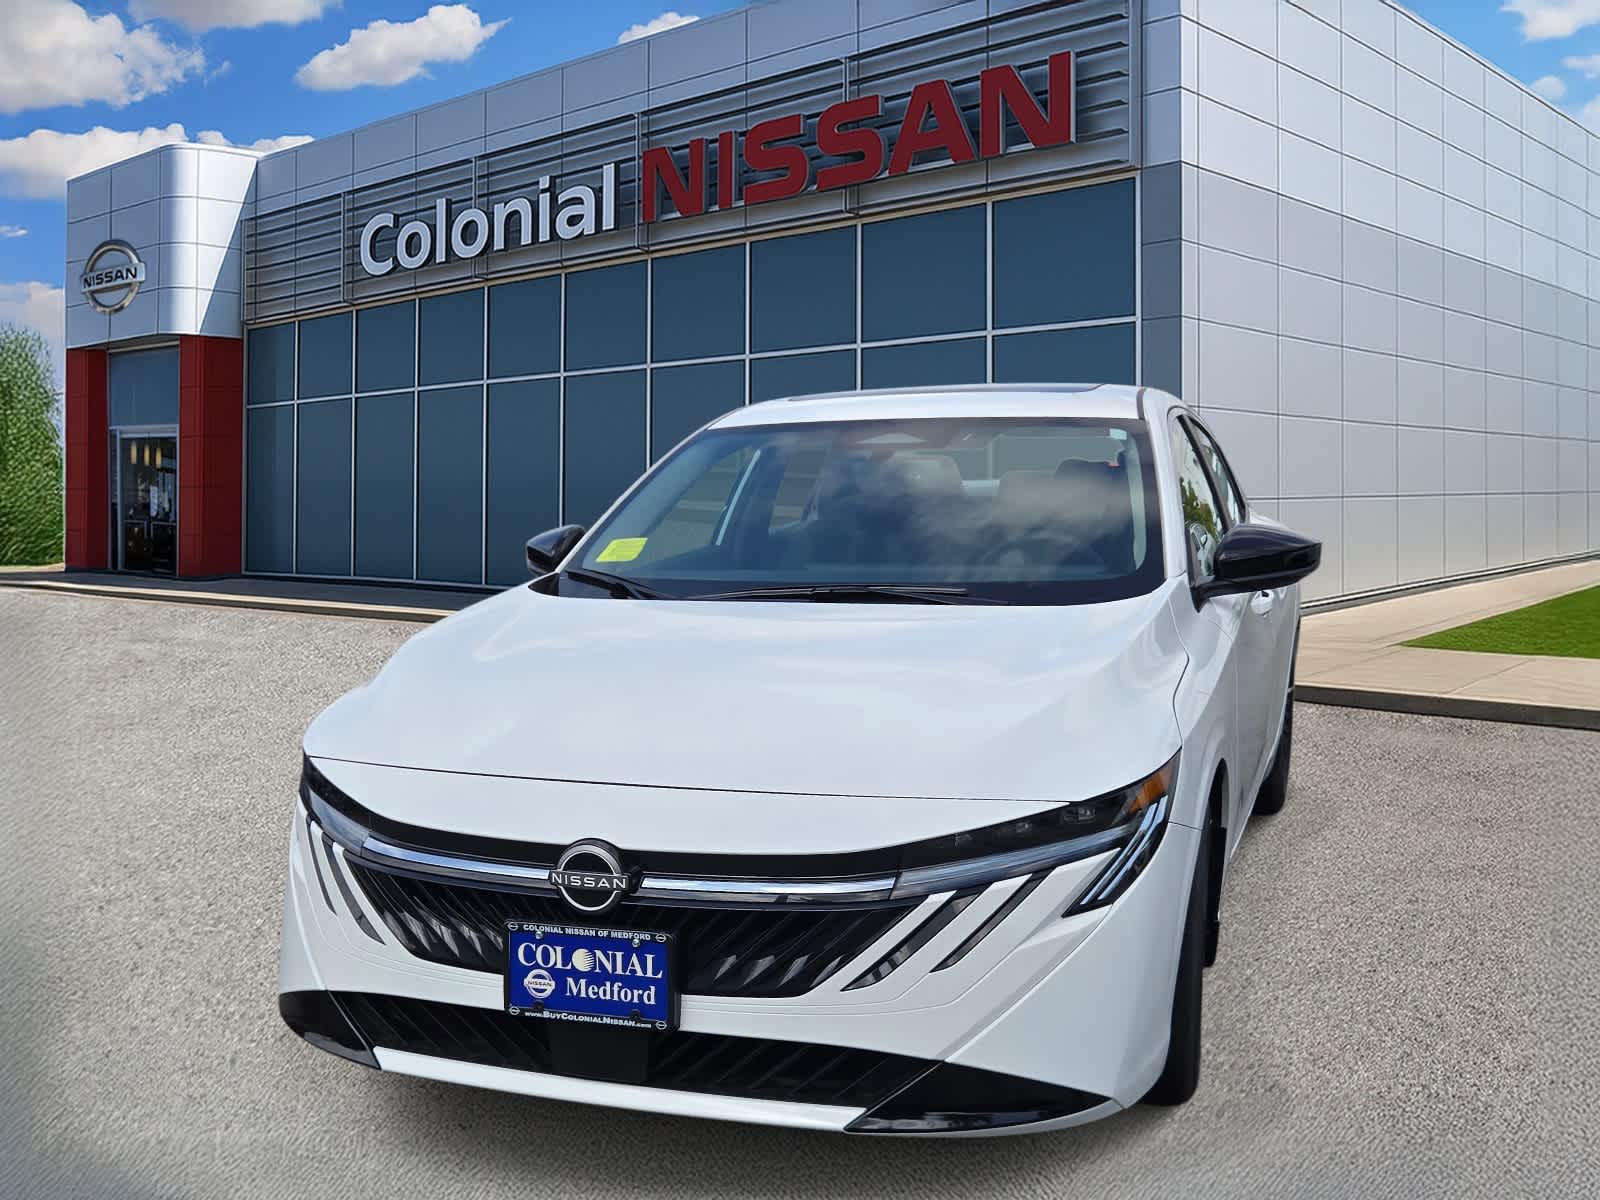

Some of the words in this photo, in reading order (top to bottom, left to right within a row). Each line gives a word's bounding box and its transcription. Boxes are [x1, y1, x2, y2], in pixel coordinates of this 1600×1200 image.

[359, 163, 615, 276] Colonial
[641, 51, 1077, 222] NISSAN
[83, 267, 138, 288] NISSAN
[552, 873, 627, 889] NISSAN
[523, 924, 564, 934] COLONIAL
[565, 927, 596, 937] NISSAN
[597, 929, 609, 938] OF
[610, 930, 651, 941] MEDFORD
[517, 942, 663, 979] COLONIAL
[527, 980, 553, 988] NISSAN
[565, 977, 656, 1005] Medford
